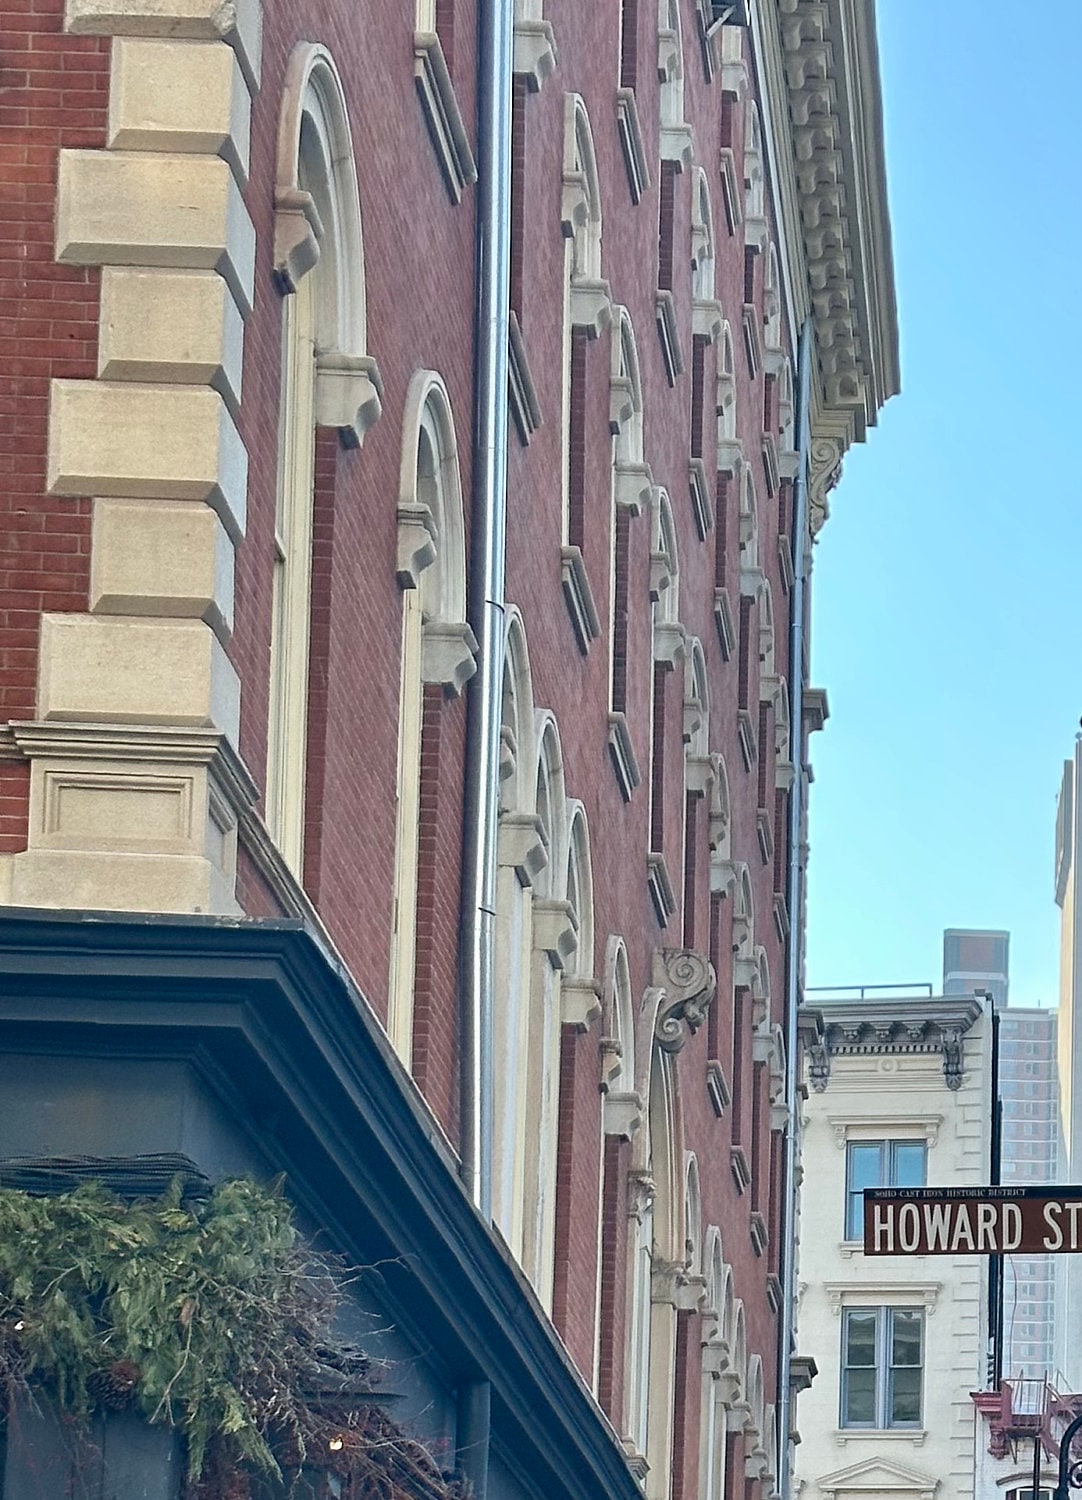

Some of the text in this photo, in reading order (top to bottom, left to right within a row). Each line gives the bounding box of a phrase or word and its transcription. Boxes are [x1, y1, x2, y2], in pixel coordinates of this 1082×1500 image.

[899, 1190, 921, 1198] CAST
[946, 1189, 986, 1197] HISTORIC
[988, 1188, 1027, 1196] DISTRICT
[873, 1202, 1023, 1252] HOWARD
